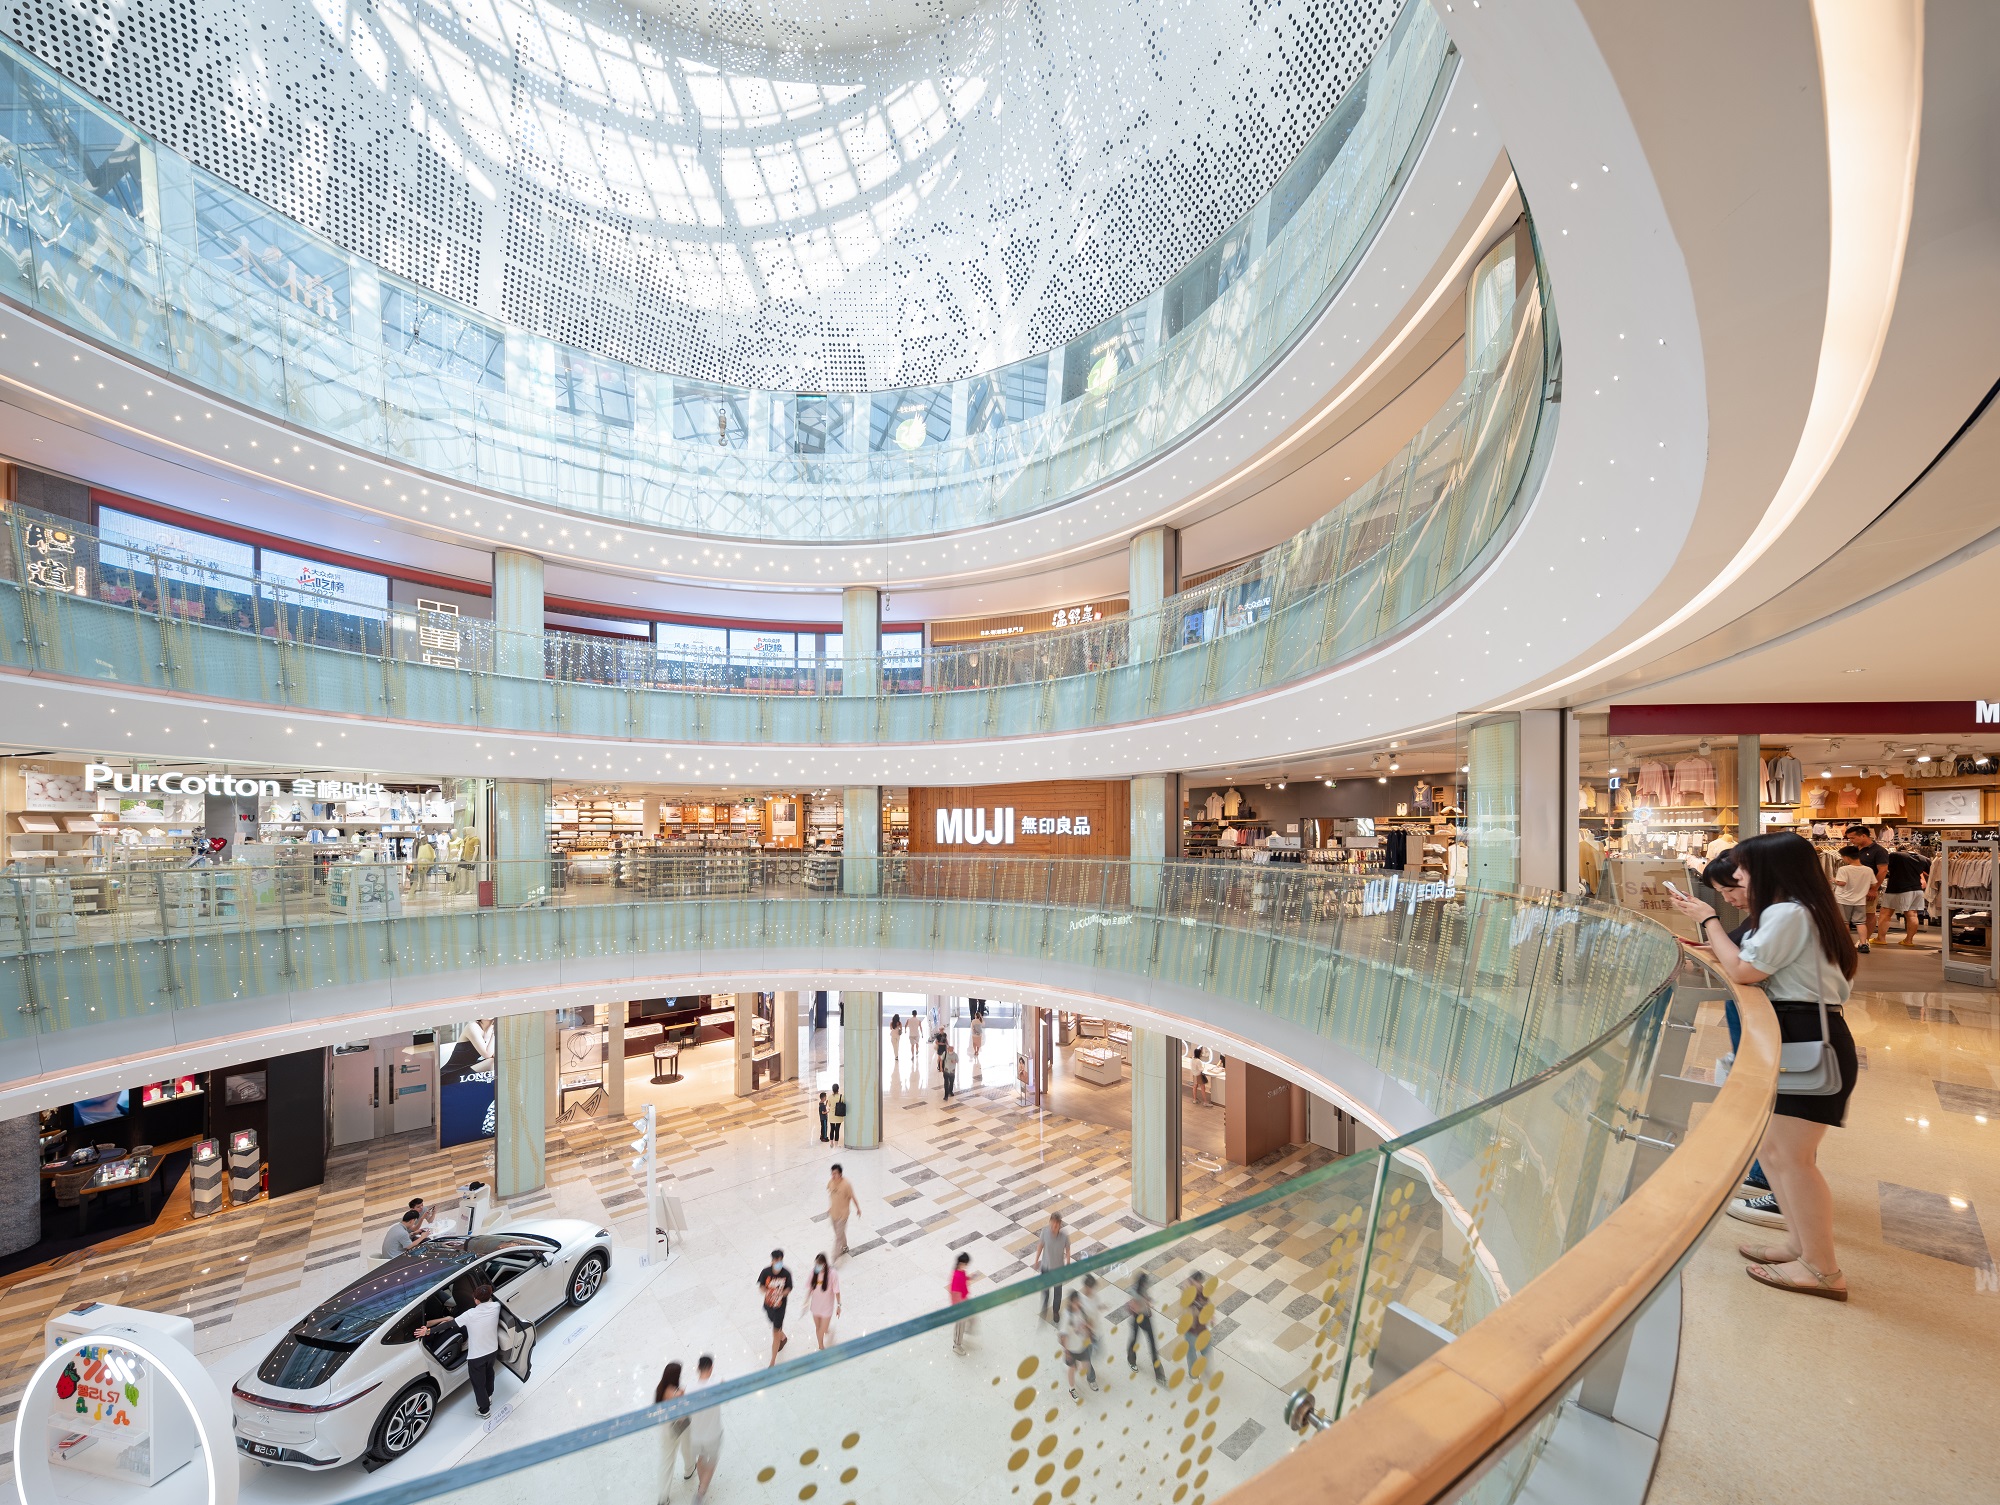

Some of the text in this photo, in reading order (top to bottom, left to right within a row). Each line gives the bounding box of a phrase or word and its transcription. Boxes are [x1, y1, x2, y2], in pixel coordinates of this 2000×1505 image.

[85, 763, 281, 798] PurCotton
[291, 778, 386, 801] 全棉时代
[935, 807, 1015, 845] MUJI
[1021, 816, 1091, 836] 無印良品
